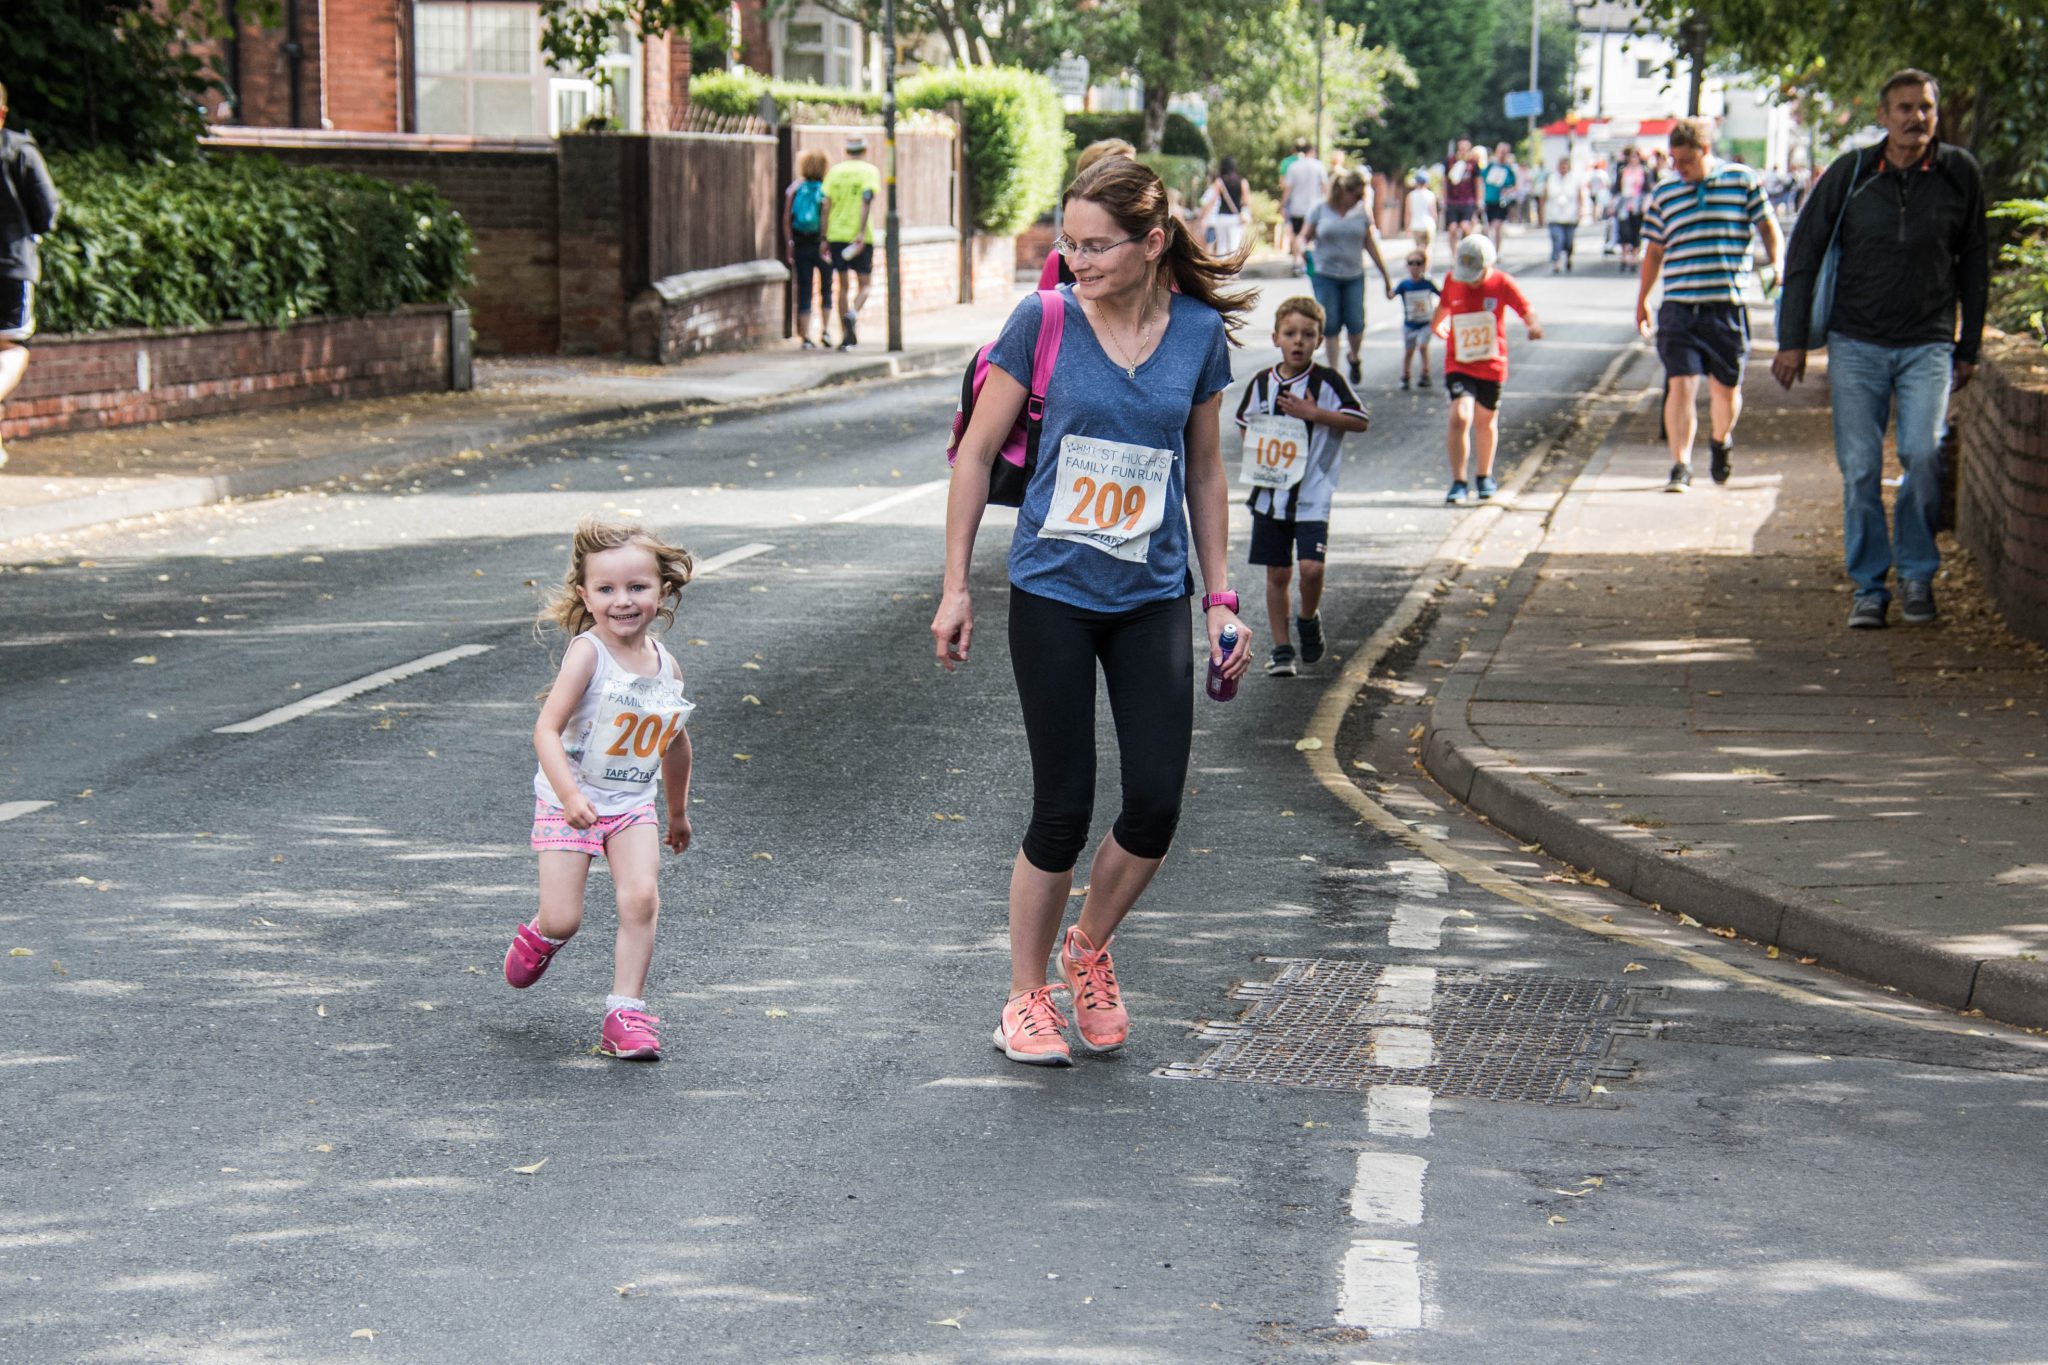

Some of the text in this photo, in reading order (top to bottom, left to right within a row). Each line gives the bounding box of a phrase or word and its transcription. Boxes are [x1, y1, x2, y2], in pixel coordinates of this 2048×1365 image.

[1461, 326, 1491, 348] 232
[1101, 448, 1118, 461] ST
[1122, 453, 1168, 469] HUGH'S
[1256, 437, 1297, 469] 109
[1066, 457, 1163, 482] FAMILY FUN RUN
[1067, 477, 1146, 530] 209
